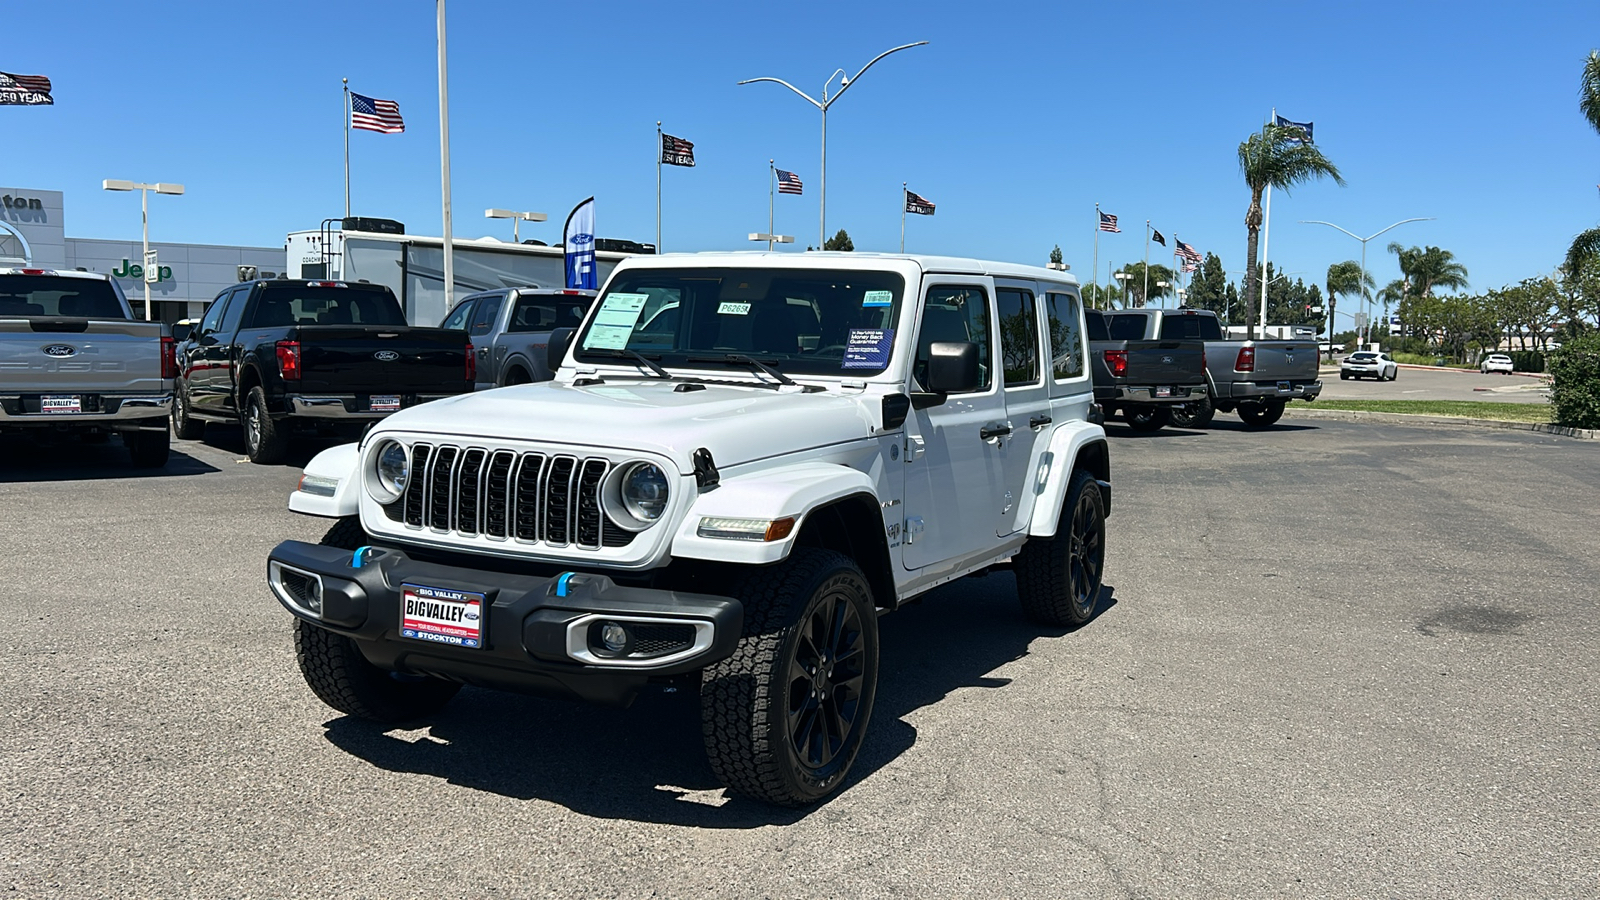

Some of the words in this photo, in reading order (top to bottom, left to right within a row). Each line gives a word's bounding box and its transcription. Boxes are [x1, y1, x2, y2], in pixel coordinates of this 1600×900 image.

[112, 258, 173, 282] Jep
[419, 588, 433, 597] BIG
[434, 591, 462, 600] VALLEY
[406, 599, 465, 623] BIGVALLEY
[417, 631, 463, 645] STOCKTON
